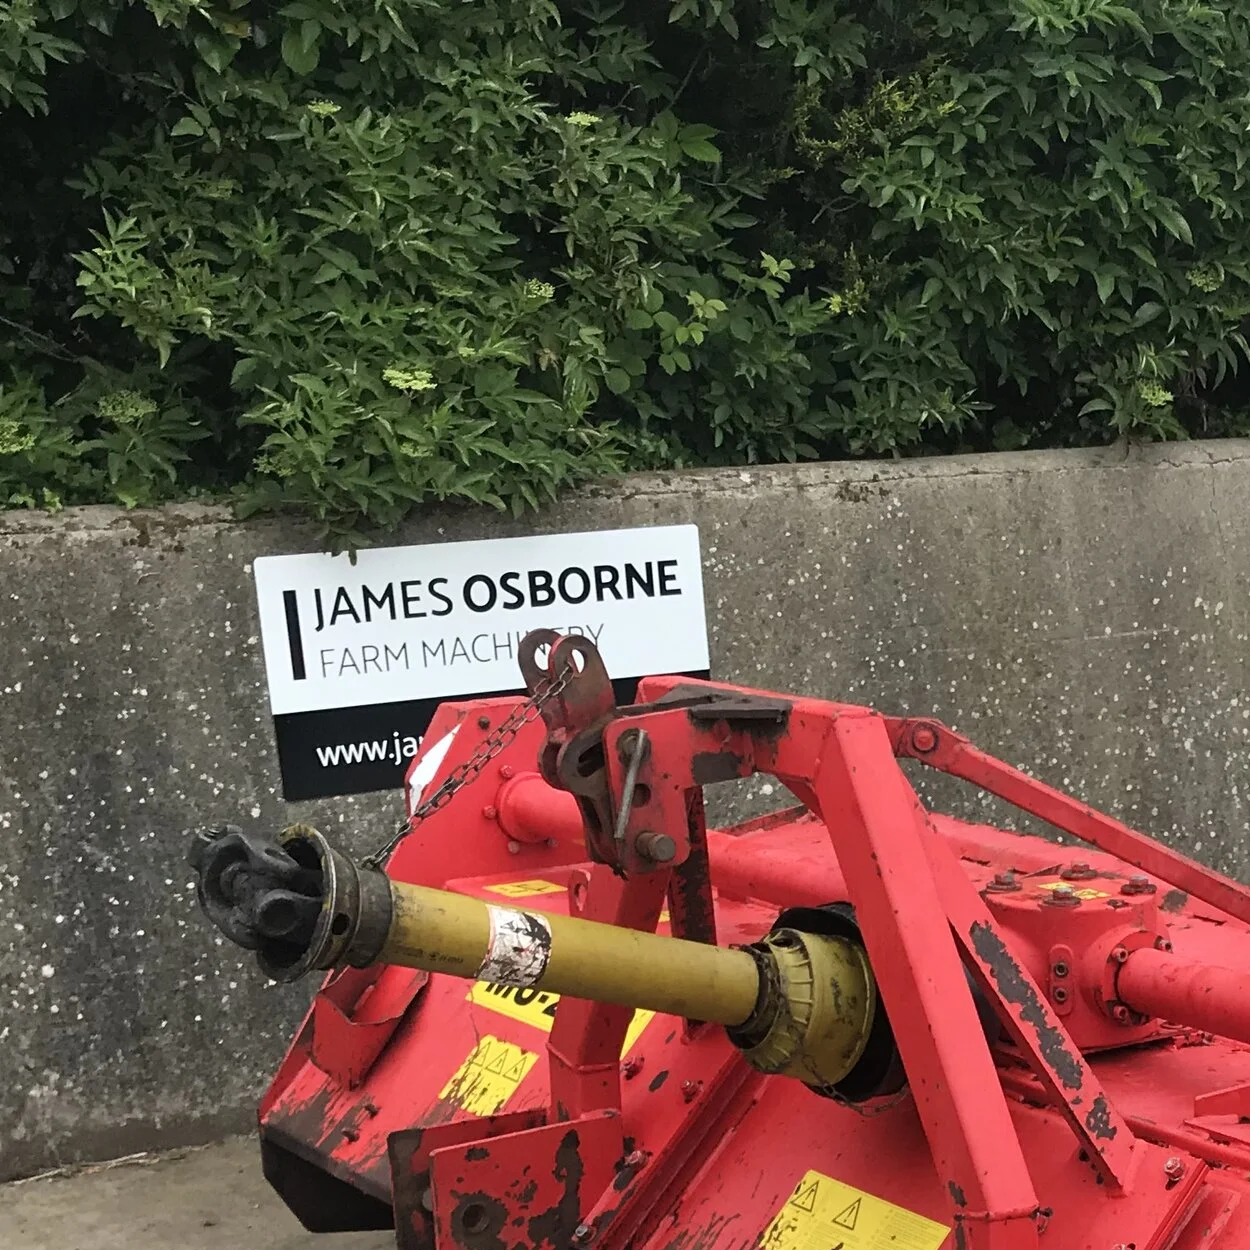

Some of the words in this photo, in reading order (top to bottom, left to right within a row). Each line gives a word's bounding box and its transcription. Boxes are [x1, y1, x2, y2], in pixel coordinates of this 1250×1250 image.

[314, 577, 454, 632] JAMES
[463, 559, 682, 610] OSBORNE
[320, 642, 410, 678] FARM
[423, 623, 605, 669] MACHY
[316, 731, 424, 767] www.ja
